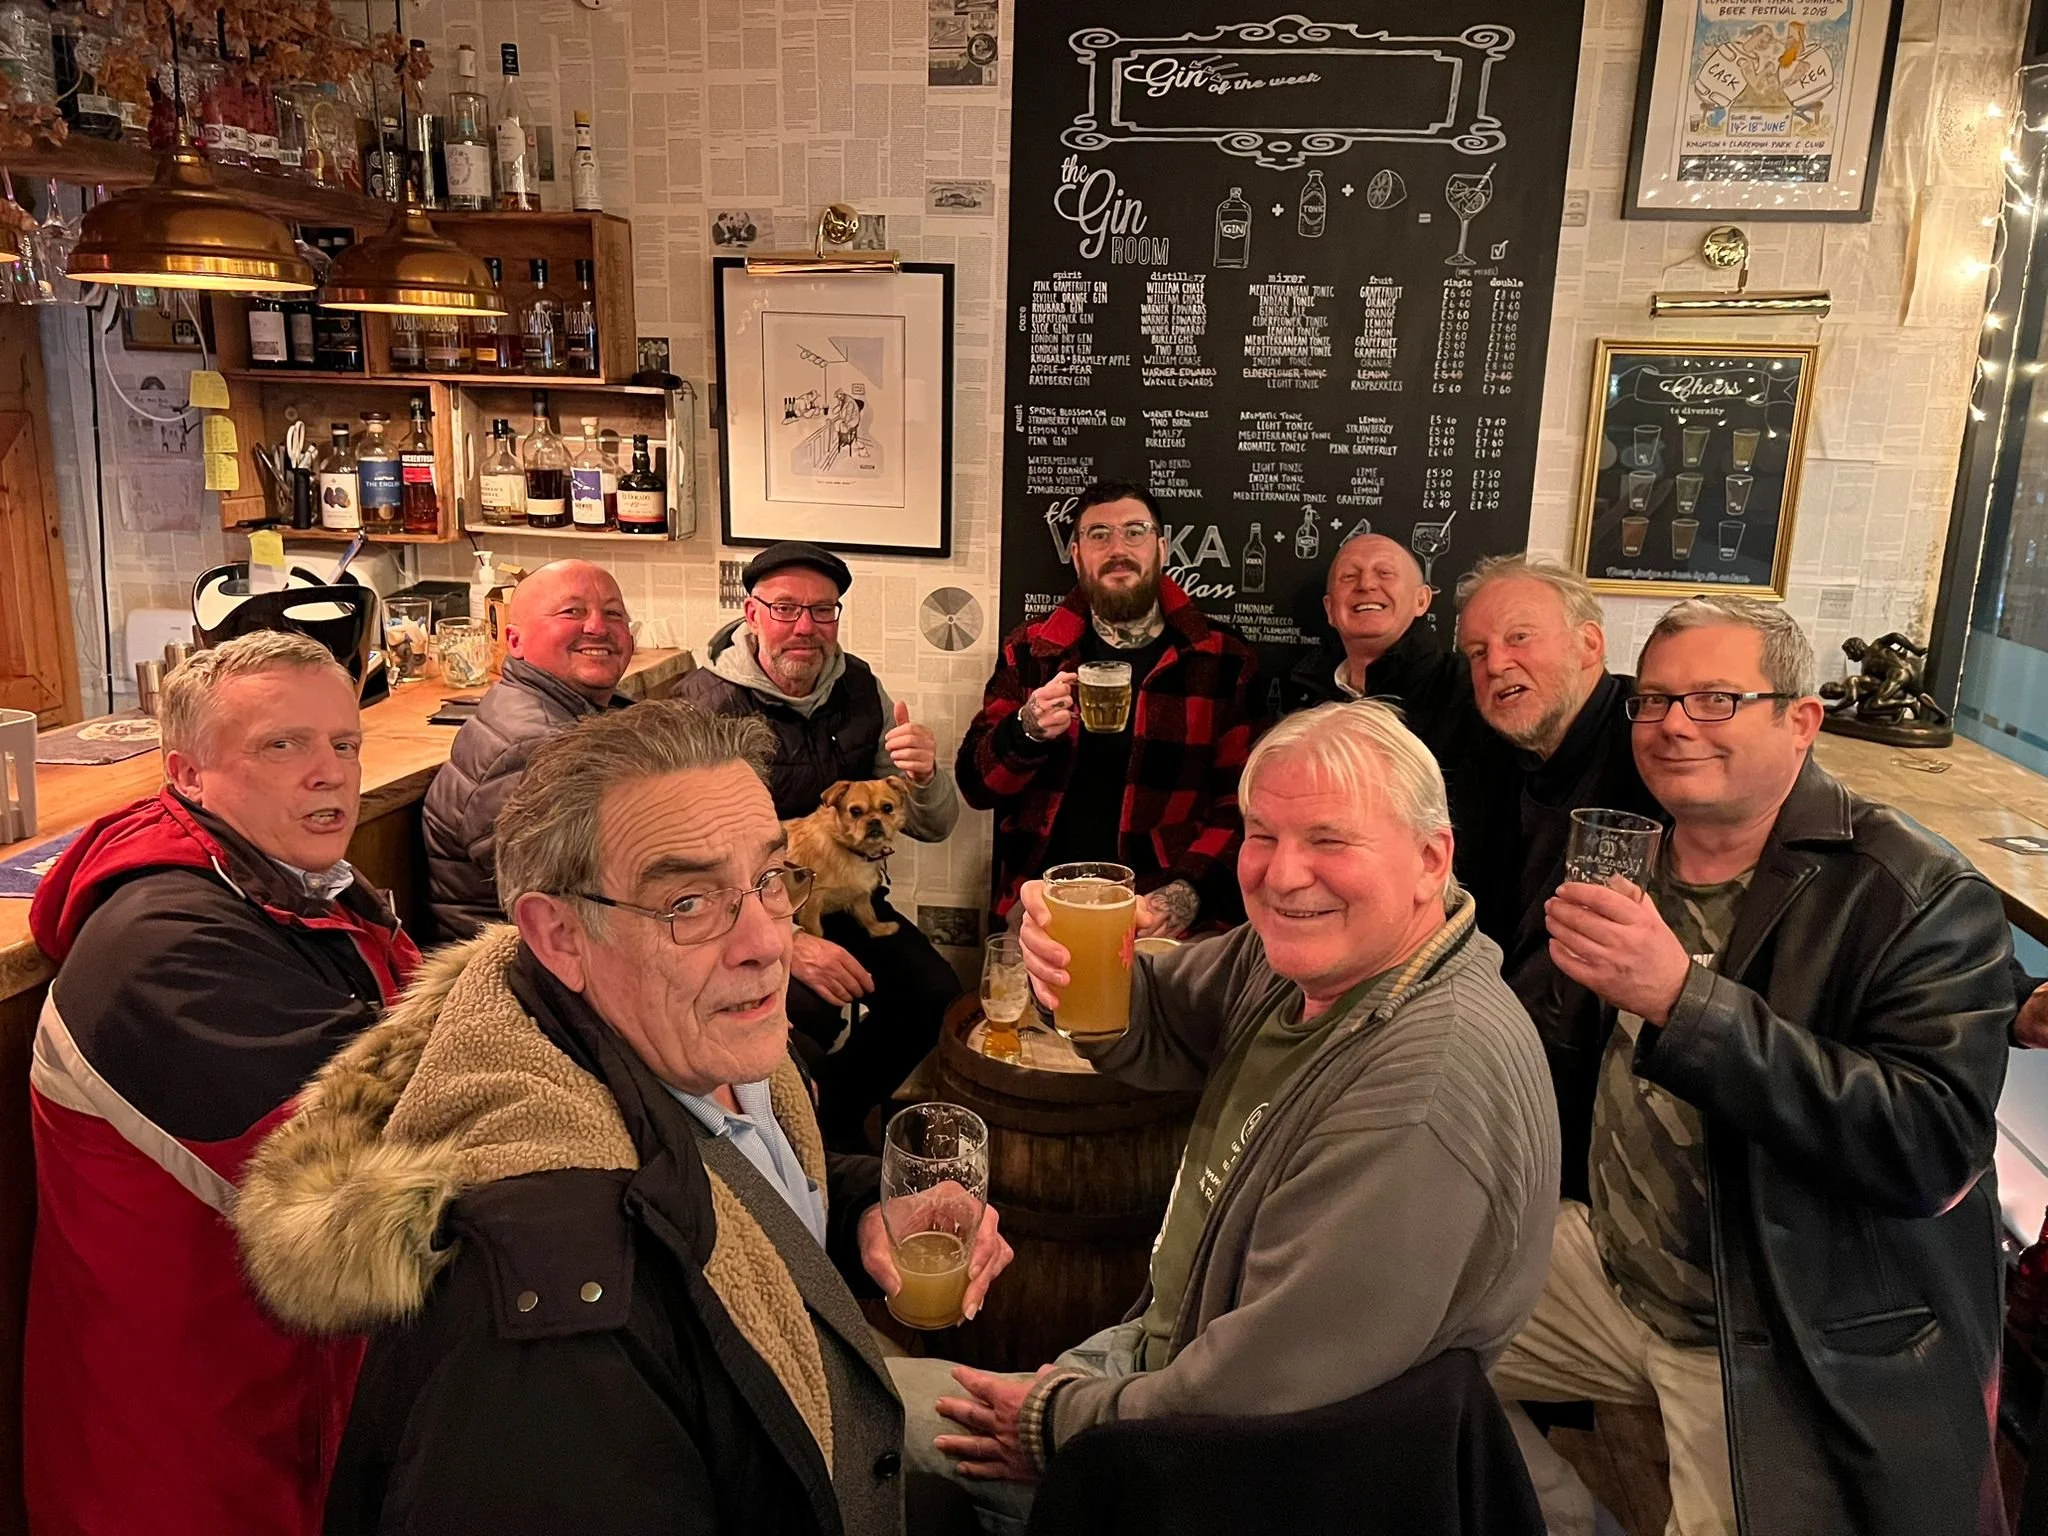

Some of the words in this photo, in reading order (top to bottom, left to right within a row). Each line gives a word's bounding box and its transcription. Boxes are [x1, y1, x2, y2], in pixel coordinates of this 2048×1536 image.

[1719, 7, 1746, 16] BEER
[1752, 6, 1796, 15] FESTIVAL
[1802, 7, 1828, 16] 2018
[1124, 56, 1208, 96] Gin
[1208, 79, 1229, 95] of
[1233, 74, 1265, 90] the
[1269, 70, 1322, 88] week
[1708, 62, 1739, 90] CASK
[1800, 65, 1827, 88] KEG
[1762, 121, 1787, 132] JUNE
[1061, 154, 1089, 184] the
[1054, 168, 1149, 258] Gin
[1302, 204, 1325, 215] TONIC
[1222, 223, 1247, 236] GIN
[1111, 236, 1169, 266] ROOM
[1053, 271, 1082, 280] spirit
[1268, 272, 1306, 283] mixer
[1369, 275, 1394, 285] fruit
[1033, 281, 1051, 292] PINK
[1093, 281, 1108, 293] GIN
[1443, 278, 1473, 288] single
[1490, 277, 1524, 287] double
[1146, 282, 1180, 294] WILLIAM
[1182, 282, 1205, 294] CHASE
[1312, 285, 1334, 297] TONIC
[1032, 293, 1057, 303] SEVILLE
[1093, 293, 1108, 304] GIN
[1146, 294, 1180, 304] WILLIAM
[1182, 294, 1204, 305] CHASE
[1260, 296, 1289, 306] INDIAN
[1292, 296, 1315, 307] TONIC
[1365, 297, 1397, 308] ORANGE
[1032, 302, 1066, 313] RHUBARB
[1070, 302, 1084, 314] GIN
[1141, 304, 1169, 315] WARNER
[1172, 304, 1207, 315] EDWARDS
[1259, 306, 1289, 316] GINGER
[1365, 308, 1396, 319] ORANGE
[1019, 306, 1027, 332] core
[1079, 313, 1094, 324] GIN
[1141, 315, 1169, 325] WARNER
[1172, 315, 1207, 325] EDWARDS
[1305, 316, 1329, 327] TONIC
[1365, 318, 1393, 329] LEMON
[1053, 323, 1068, 334] GIN
[1364, 329, 1393, 337] LEMON
[1031, 334, 1059, 344] LONDON
[1061, 334, 1076, 344] DRY
[1077, 333, 1093, 344] GIN
[1309, 336, 1331, 346] TONIC
[1031, 344, 1059, 354] LONDON
[1061, 344, 1076, 354] DRY
[1077, 344, 1092, 355] GIN
[1155, 345, 1172, 355] TWO
[1175, 345, 1197, 355] BIRDS
[1030, 354, 1065, 364] RHUBARB
[1072, 354, 1108, 365] BRAMLEY
[1143, 355, 1177, 365] WILLIAM
[1252, 357, 1281, 367] INDIAN
[1030, 364, 1059, 374] APPLE
[1069, 365, 1093, 374] PEAR
[1074, 376, 1090, 386] GIN
[1295, 379, 1319, 389] TONIC
[1659, 375, 1742, 399] Cheers
[1029, 406, 1057, 416] SPRING
[1060, 408, 1092, 416] BLOSSOM
[1681, 406, 1725, 417] diversity
[1110, 416, 1126, 426] GIN
[1150, 418, 1168, 427] TWO
[1172, 418, 1192, 427] BIRDS
[1358, 416, 1386, 424] LEMON
[1028, 426, 1058, 435] LEMON
[1061, 426, 1078, 435] GIN
[1257, 421, 1282, 431] LIGHT
[1285, 422, 1314, 431] TONIC
[1345, 424, 1394, 434] STRAWBERRY
[1153, 429, 1183, 438] MALFY
[1028, 436, 1048, 446] PINK
[1053, 436, 1067, 446] GIN
[1356, 435, 1386, 444] LEMON
[1238, 441, 1276, 452] AROMATIC
[1279, 442, 1307, 452] TONIC
[1329, 444, 1350, 454] PINK
[1027, 456, 1077, 465] WATERMELON
[1080, 457, 1094, 466] GIN
[1149, 460, 1167, 469] TWO
[1028, 466, 1054, 475] BLOOD
[1057, 466, 1089, 477] ORANGE
[1252, 462, 1275, 473] LIGHT
[1279, 463, 1303, 473] TONIC
[1356, 467, 1378, 477] LIME
[1027, 476, 1053, 485] PARMA
[1248, 473, 1279, 483] INDIAN
[1350, 477, 1384, 487] ORANGE
[1178, 488, 1204, 498] MONK
[1251, 483, 1273, 492] LIGHT
[1277, 483, 1301, 492] TONIC
[1353, 486, 1379, 495] LEMON
[1233, 491, 1300, 502] MEDITERRANEAN
[1302, 494, 1327, 503] TONIC
[1336, 495, 1383, 506] GRAPEFRUIT
[1043, 497, 1080, 524] th
[1049, 522, 1231, 568] VKA
[1025, 593, 1051, 604] SALTED
[1235, 603, 1275, 614] LEMONADE
